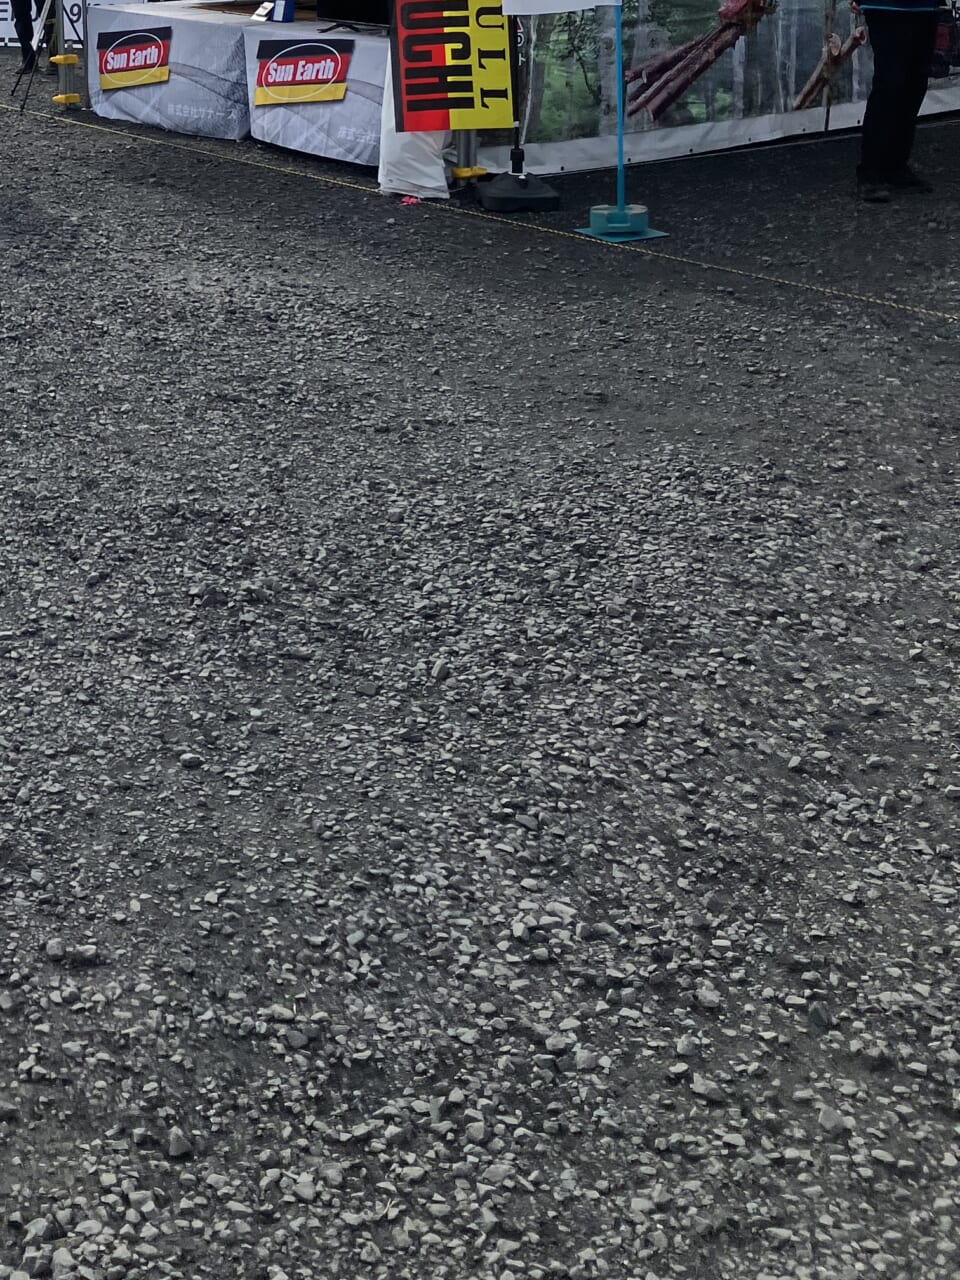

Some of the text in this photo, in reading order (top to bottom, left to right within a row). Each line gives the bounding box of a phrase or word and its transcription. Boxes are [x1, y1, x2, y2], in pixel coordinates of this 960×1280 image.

[106, 44, 158, 70] Sun Earth
[267, 59, 336, 83] Sun Earth
